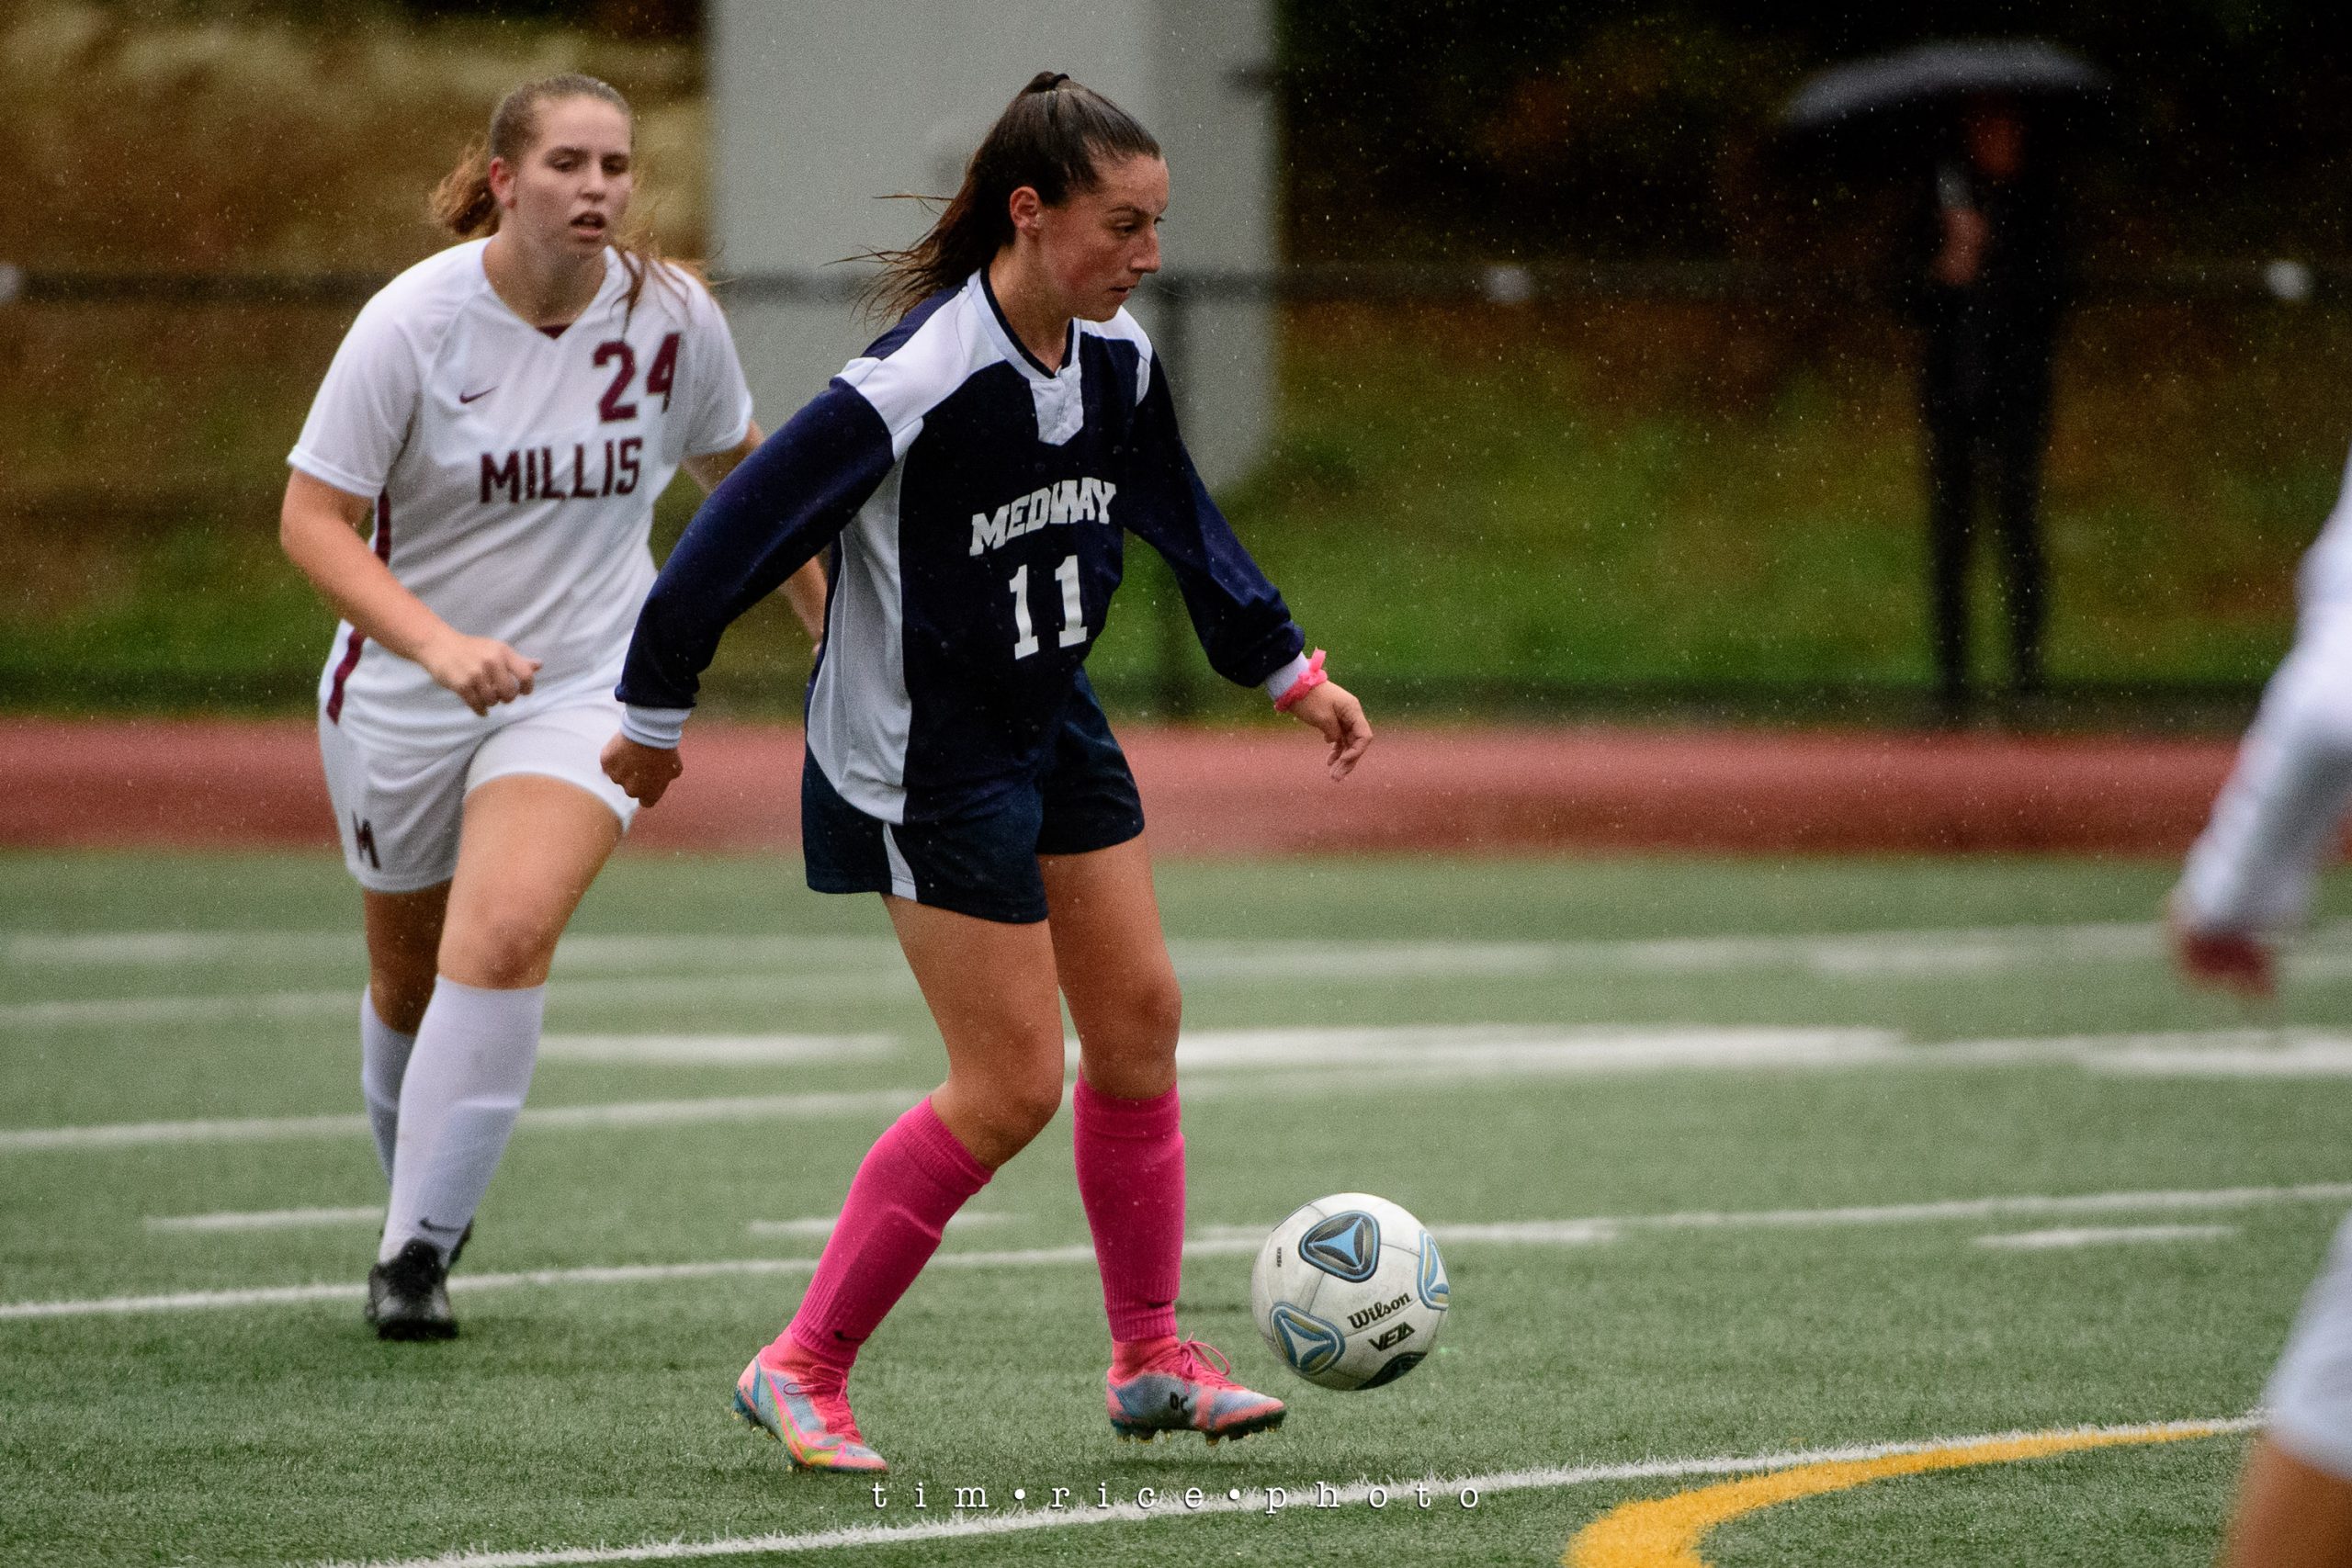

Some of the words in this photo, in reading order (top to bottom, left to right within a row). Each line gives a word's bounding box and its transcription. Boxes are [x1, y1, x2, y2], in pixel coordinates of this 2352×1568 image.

[593, 332, 681, 423] 24
[480, 435, 643, 504] MILLIS
[970, 477, 1116, 556] MEDWAY
[1009, 554, 1088, 660] 11
[1347, 1292, 1411, 1329] Wilson
